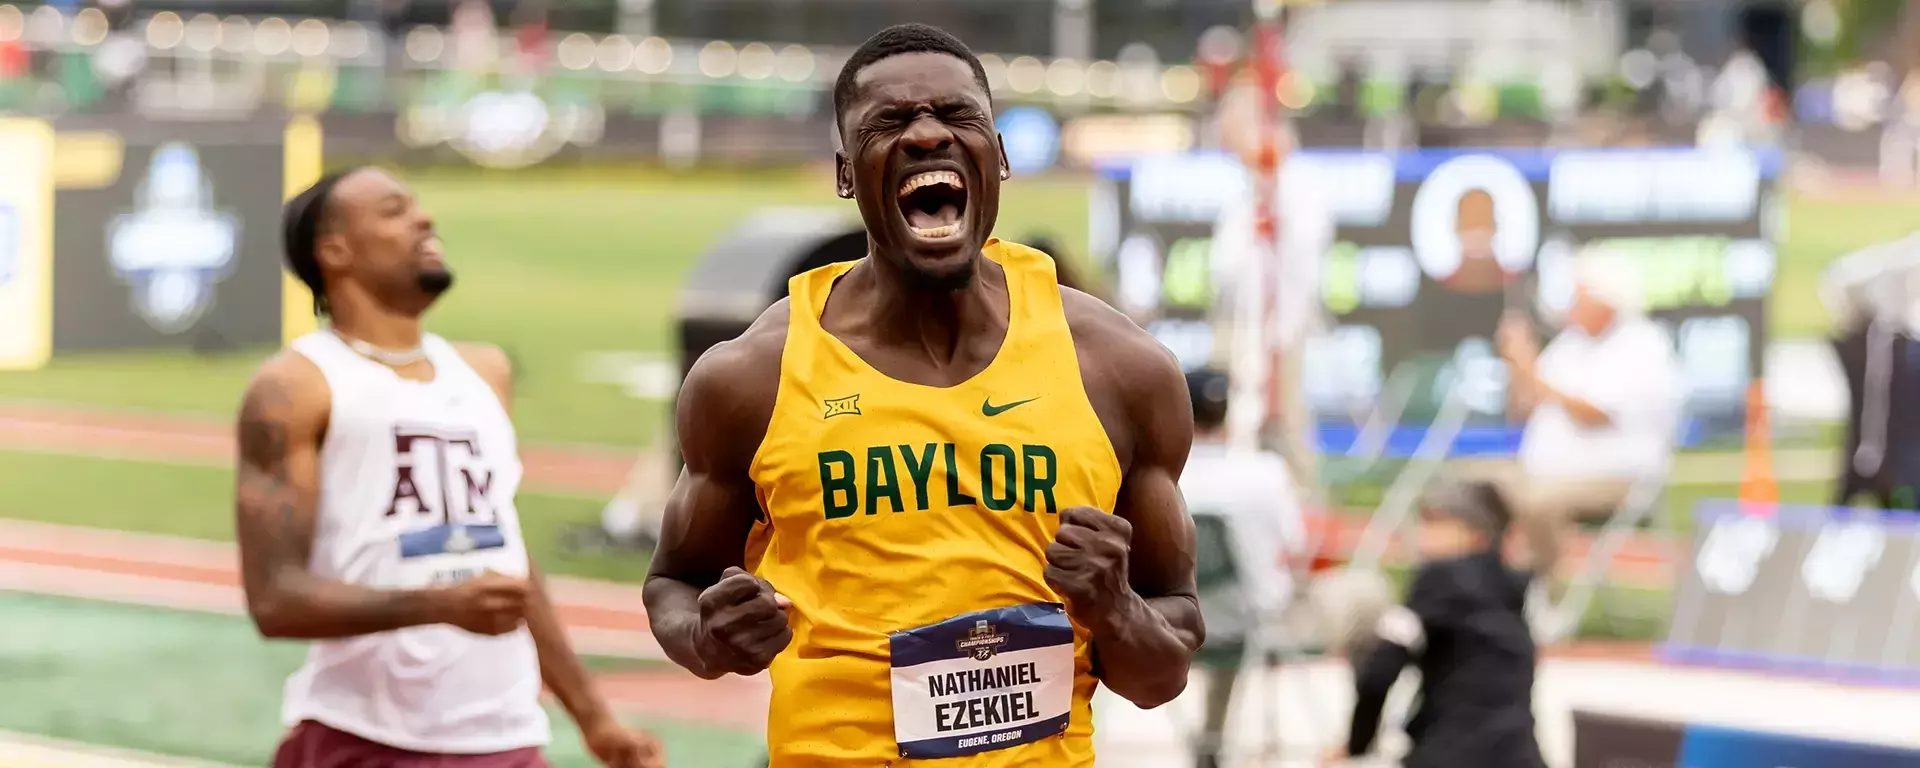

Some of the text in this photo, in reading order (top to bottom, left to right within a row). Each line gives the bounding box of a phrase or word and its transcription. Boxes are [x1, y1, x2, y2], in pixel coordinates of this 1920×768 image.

[817, 442, 1058, 520] BAYLOR
[960, 637, 1004, 648] CHAMPIONSHIPS
[928, 662, 1041, 698] NATHANIEL
[935, 691, 1040, 732] EZEKIEL
[958, 729, 1022, 749] EUGENE, OREGON
